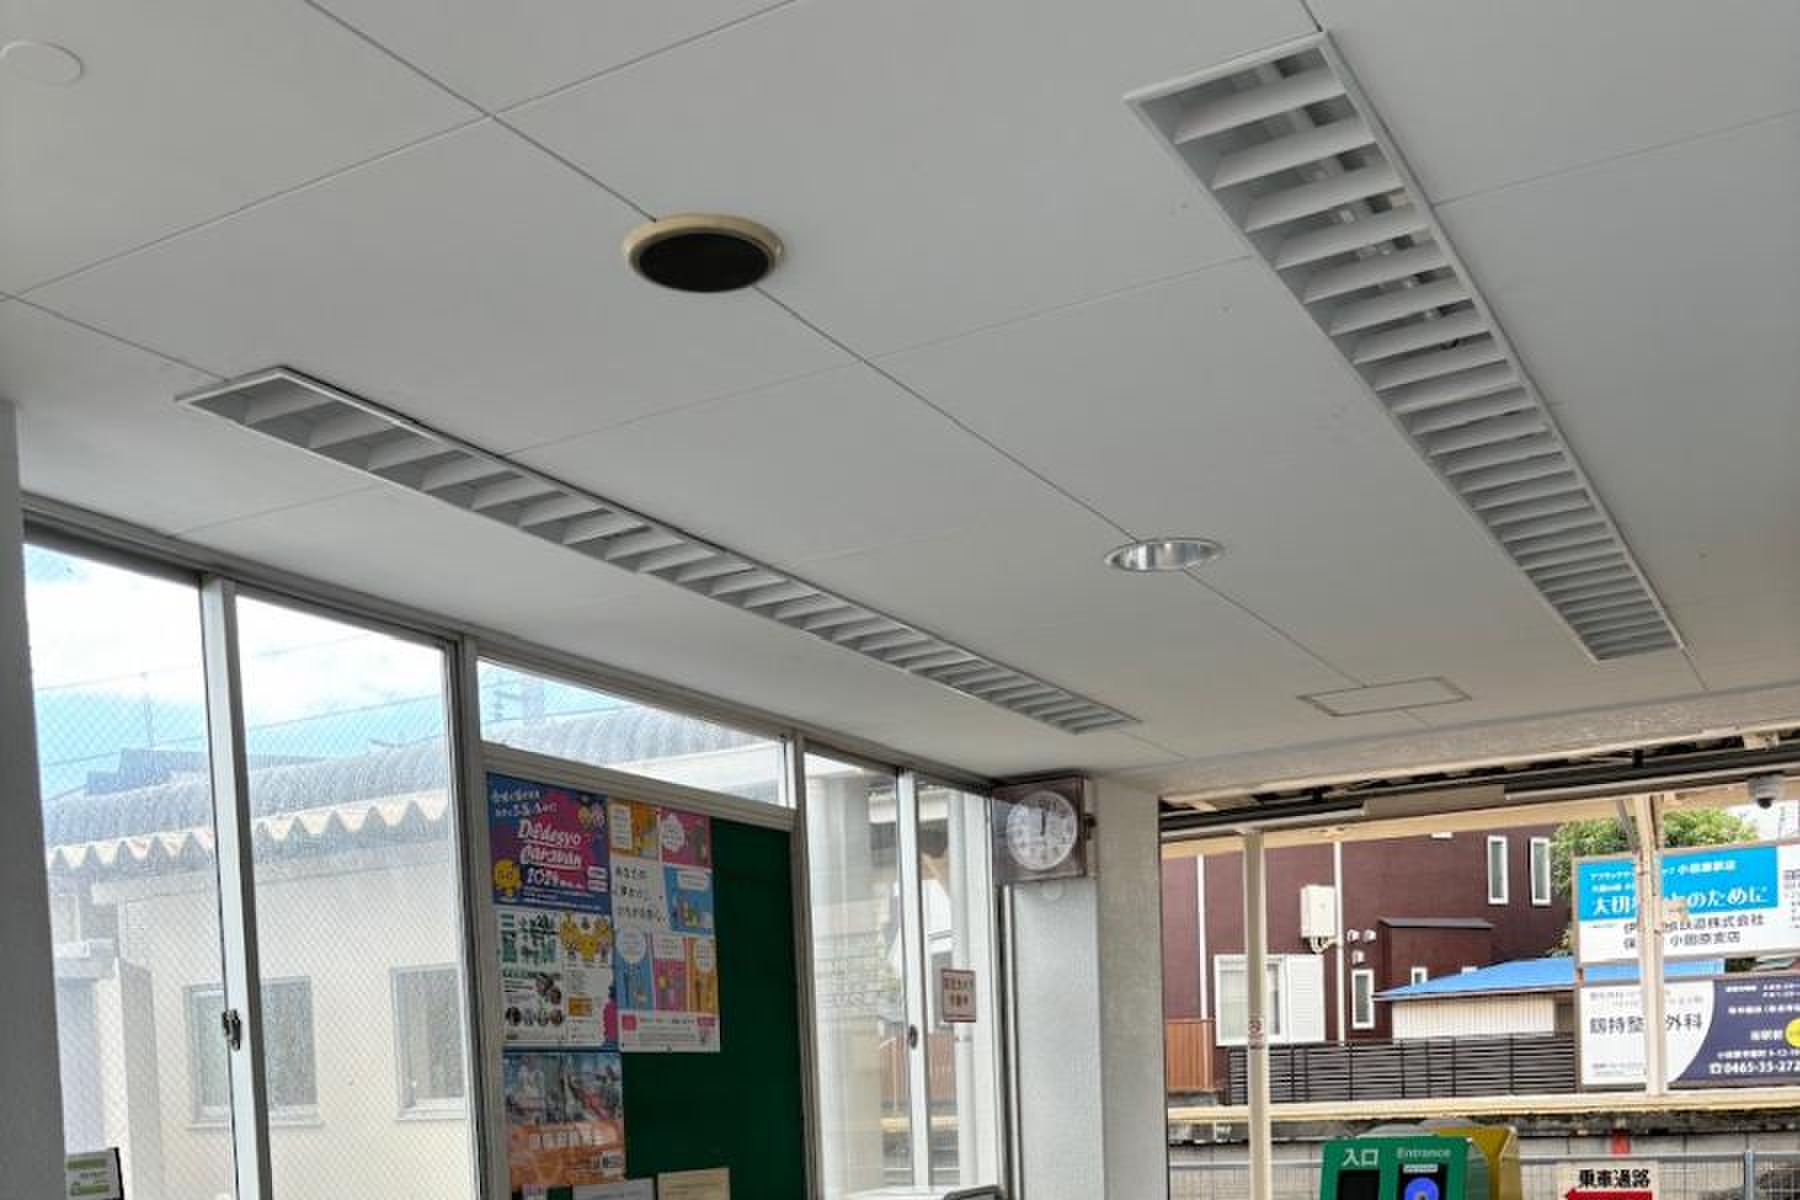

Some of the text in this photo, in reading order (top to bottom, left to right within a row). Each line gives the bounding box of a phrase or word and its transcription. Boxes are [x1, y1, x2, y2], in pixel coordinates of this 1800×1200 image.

[1593, 887, 1769, 915] 大切のために
[1342, 1148, 1379, 1167] 入口
[1397, 1147, 1452, 1159] Entrance
[1578, 1168, 1650, 1188] 乗車通路
